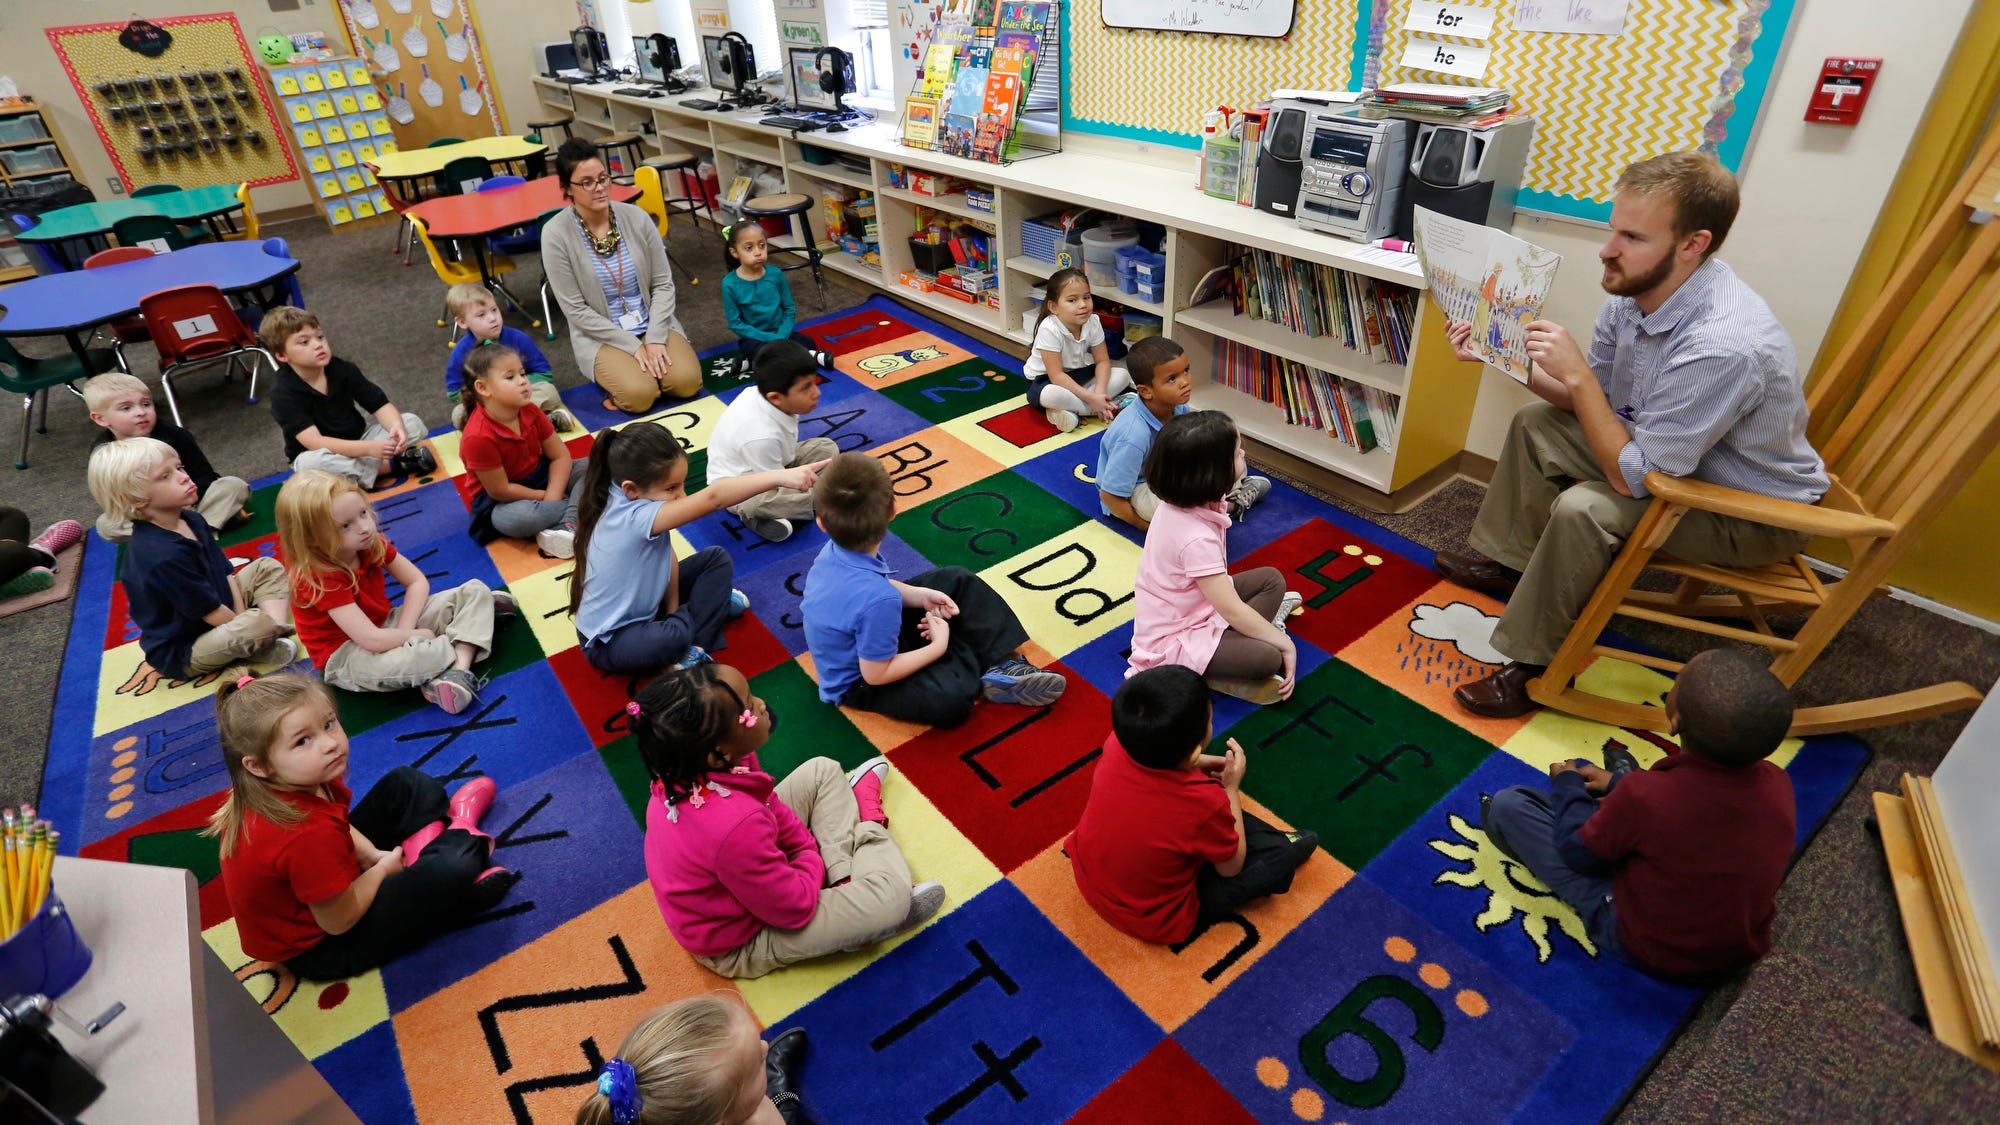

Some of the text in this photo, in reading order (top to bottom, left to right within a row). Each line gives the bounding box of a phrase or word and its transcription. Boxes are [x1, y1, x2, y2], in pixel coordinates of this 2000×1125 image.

[1436, 8, 1463, 27] for
[1518, 0, 1593, 23] the like
[790, 25, 810, 39] green
[976, 47, 988, 57] CAT
[1433, 46, 1456, 65] he
[1826, 60, 1877, 70] FIRE ALARM
[150, 242, 162, 254] 1
[190, 321, 202, 334] 1
[823, 324, 877, 344] 1
[920, 376, 986, 403] 2
[877, 441, 949, 497] Bb
[930, 491, 1018, 557] Cc
[1006, 542, 1136, 627] Dd
[1295, 549, 1376, 610] 4
[1258, 693, 1434, 803] Ff
[868, 938, 1045, 1125] Tt
[1298, 974, 1446, 1110] 6
